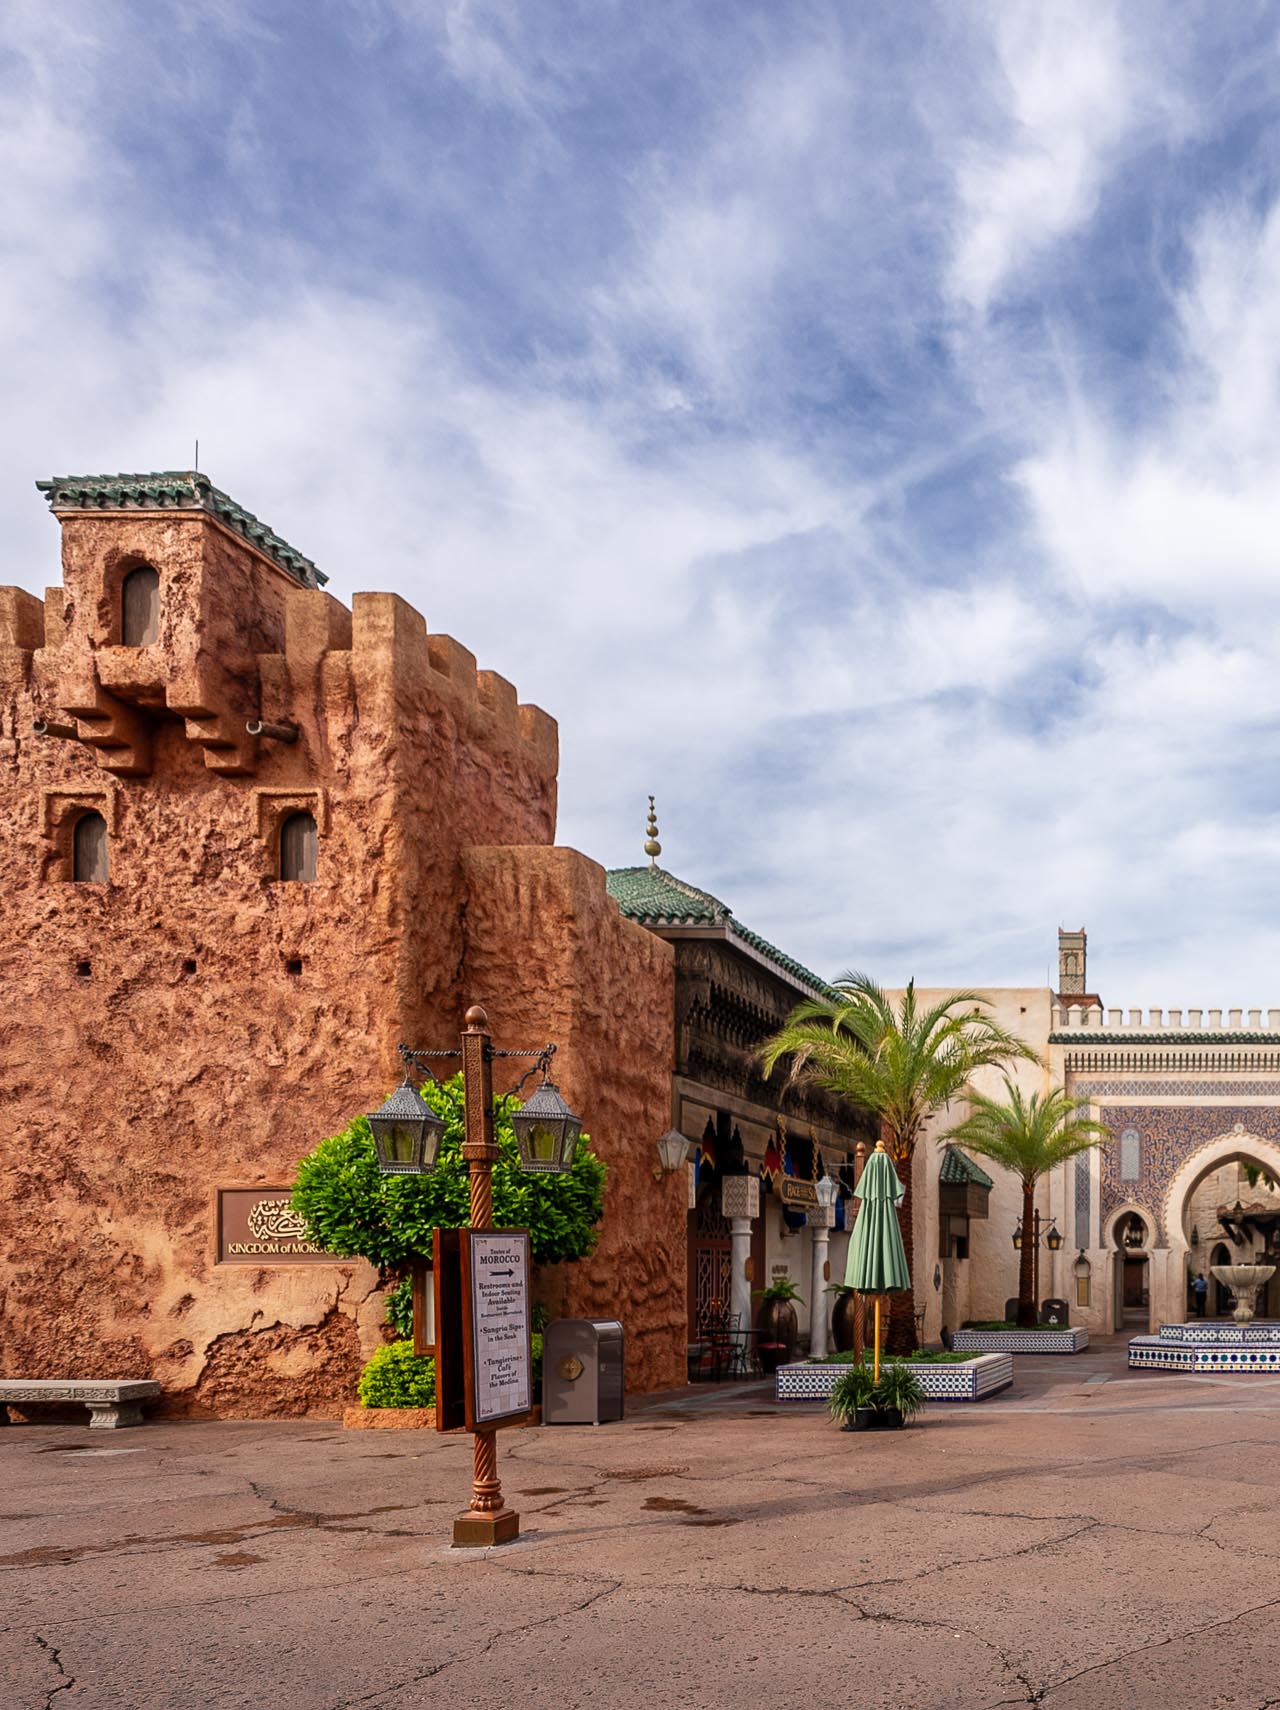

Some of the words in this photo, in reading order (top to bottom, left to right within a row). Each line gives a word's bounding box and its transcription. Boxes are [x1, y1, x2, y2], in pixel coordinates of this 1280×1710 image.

[228, 1243, 279, 1254] KINGDOM
[280, 1243, 291, 1254] of
[480, 1255, 520, 1264] MOROCCO
[511, 1280, 523, 1288] and
[488, 1297, 515, 1306] Available
[483, 1325, 508, 1334] Sangria
[487, 1356, 519, 1365] Tangierine
[491, 1372, 510, 1381] Flavors
